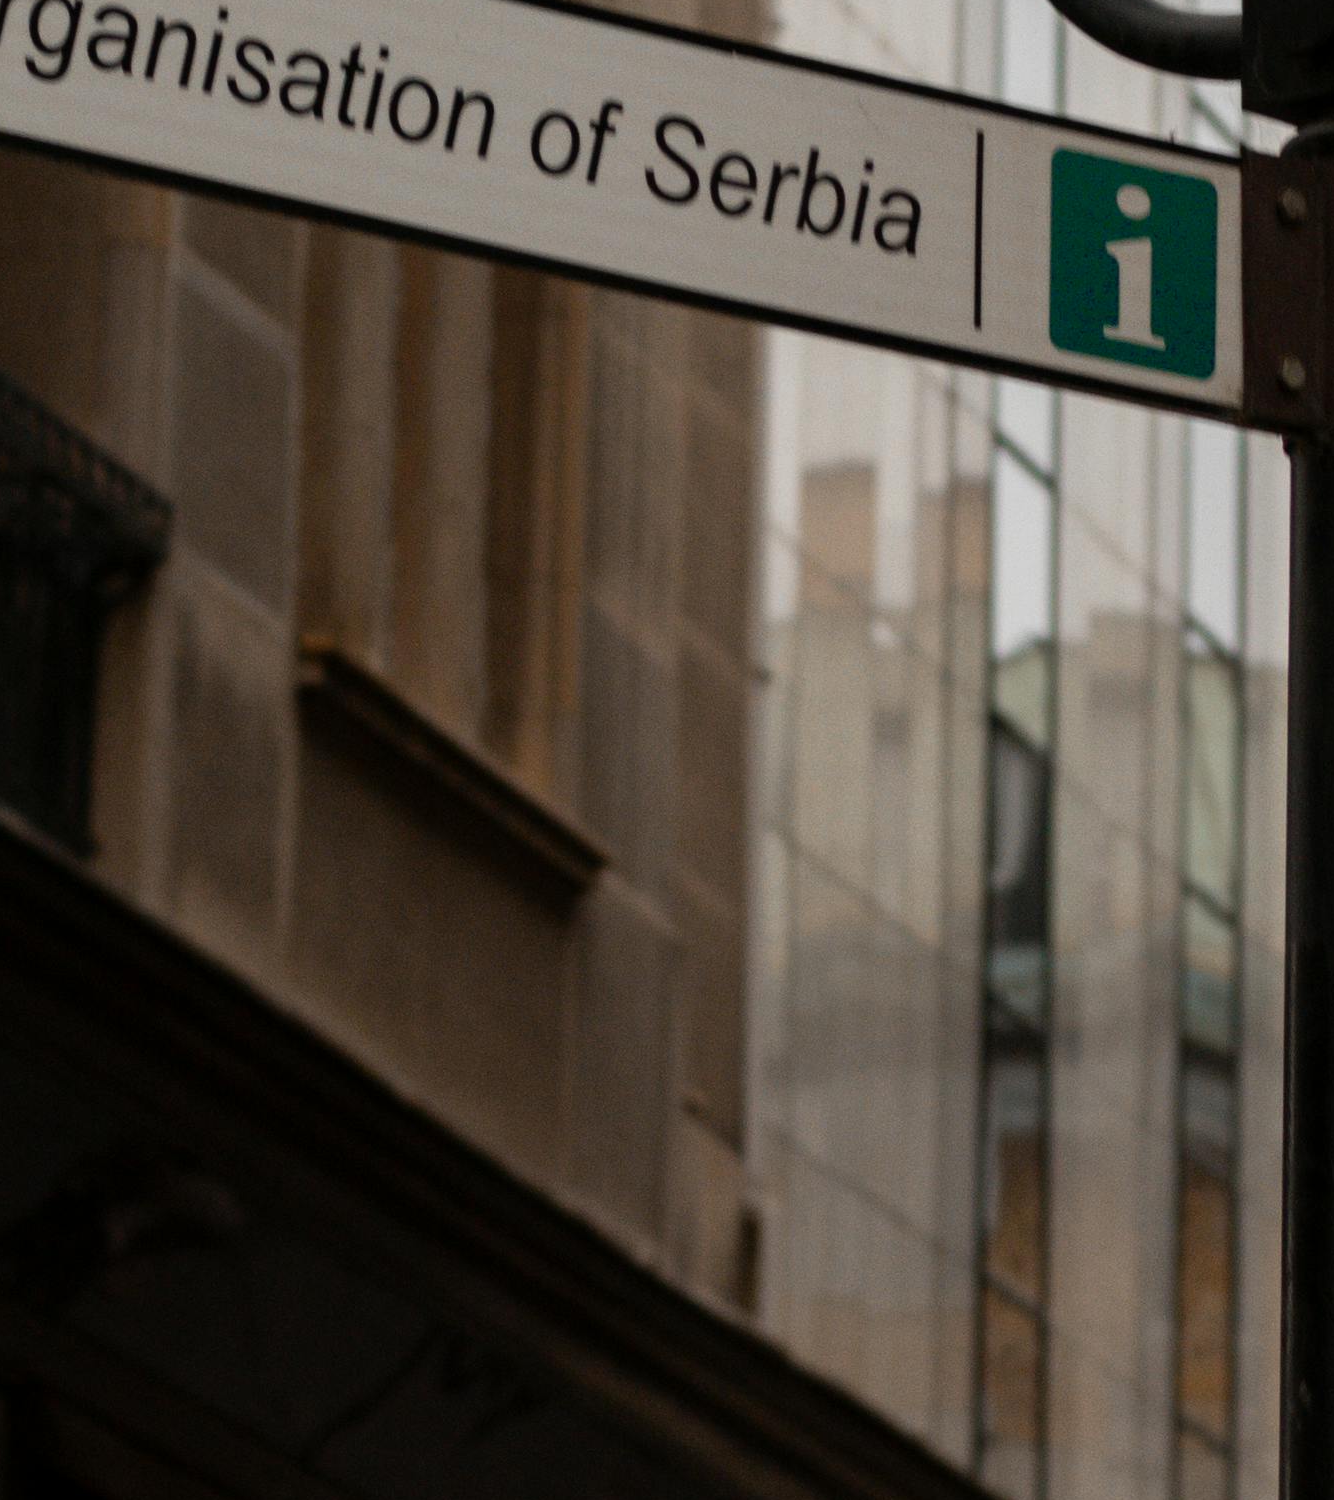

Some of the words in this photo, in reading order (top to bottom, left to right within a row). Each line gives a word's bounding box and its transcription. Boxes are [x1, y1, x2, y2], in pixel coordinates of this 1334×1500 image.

[528, 97, 625, 187] of
[643, 112, 923, 260] Serbia
[1102, 185, 1166, 350] i
